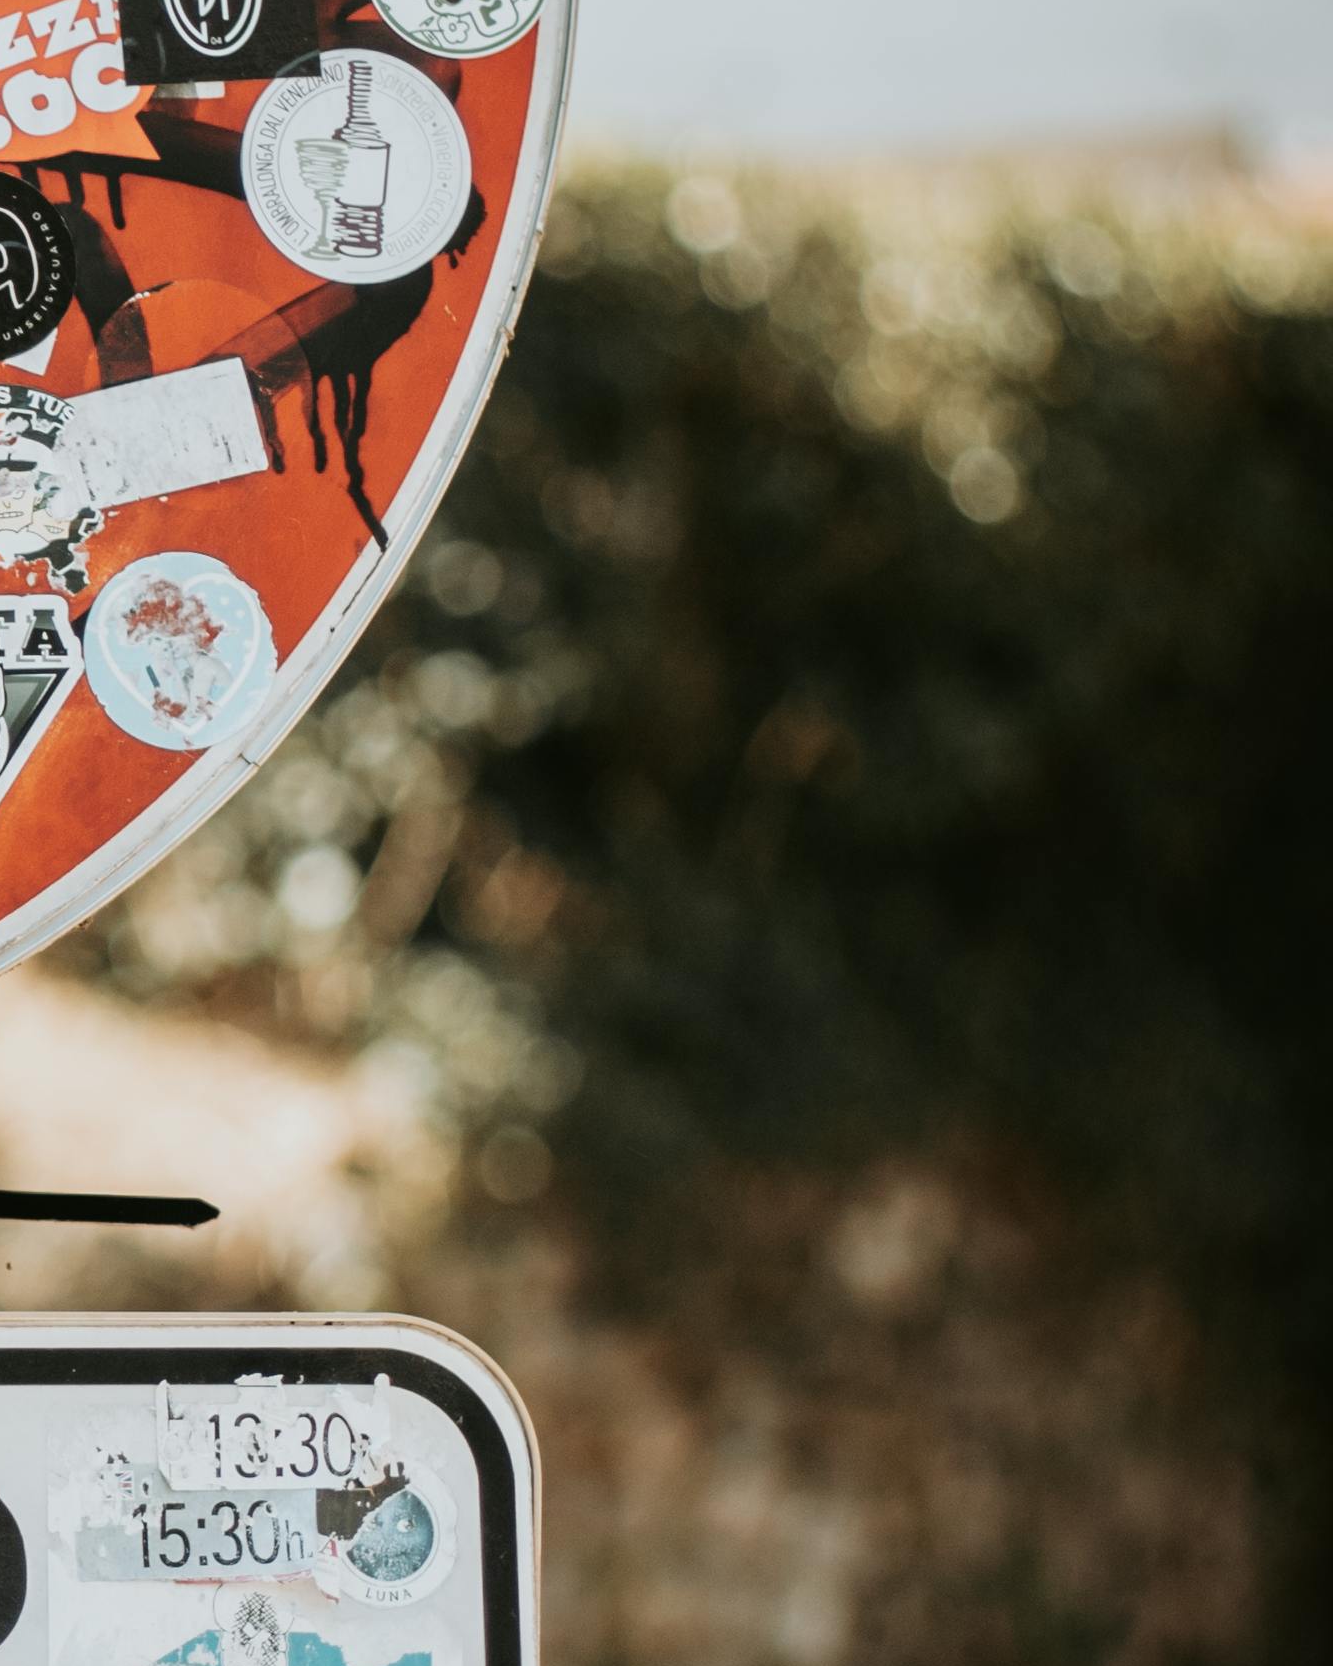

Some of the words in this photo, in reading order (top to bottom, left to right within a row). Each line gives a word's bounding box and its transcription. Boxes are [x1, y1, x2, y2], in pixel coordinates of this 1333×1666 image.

[259, 112, 284, 141] DAL
[274, 62, 345, 114] VENEZIANO
[27, 389, 79, 423] TUS
[365, 1586, 413, 1603] LUNA
